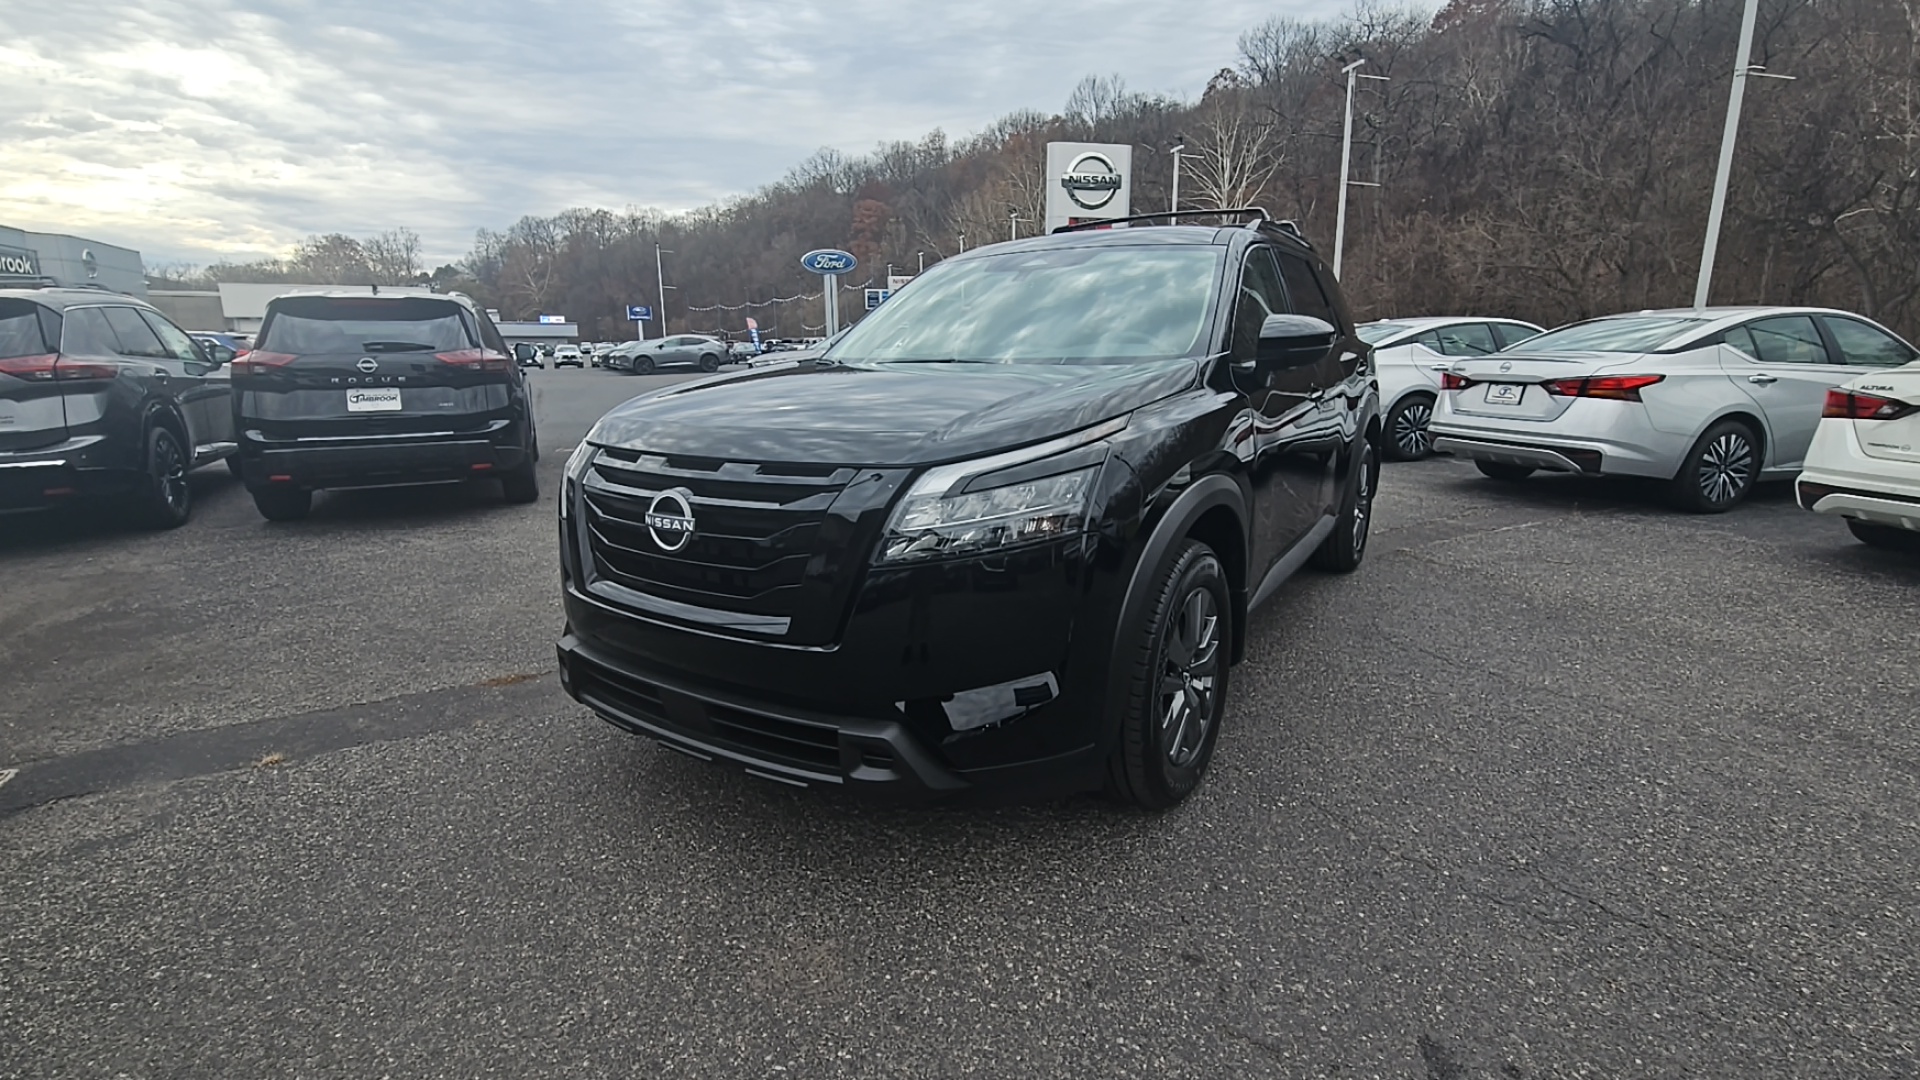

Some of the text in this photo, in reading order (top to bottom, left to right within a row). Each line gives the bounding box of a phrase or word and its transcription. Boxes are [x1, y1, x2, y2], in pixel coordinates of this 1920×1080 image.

[1068, 175, 1117, 185] NISSAN
[0, 255, 33, 274] rook
[814, 254, 846, 269] Ford
[331, 376, 406, 384] ROGUE
[645, 514, 694, 531] NISSAN
